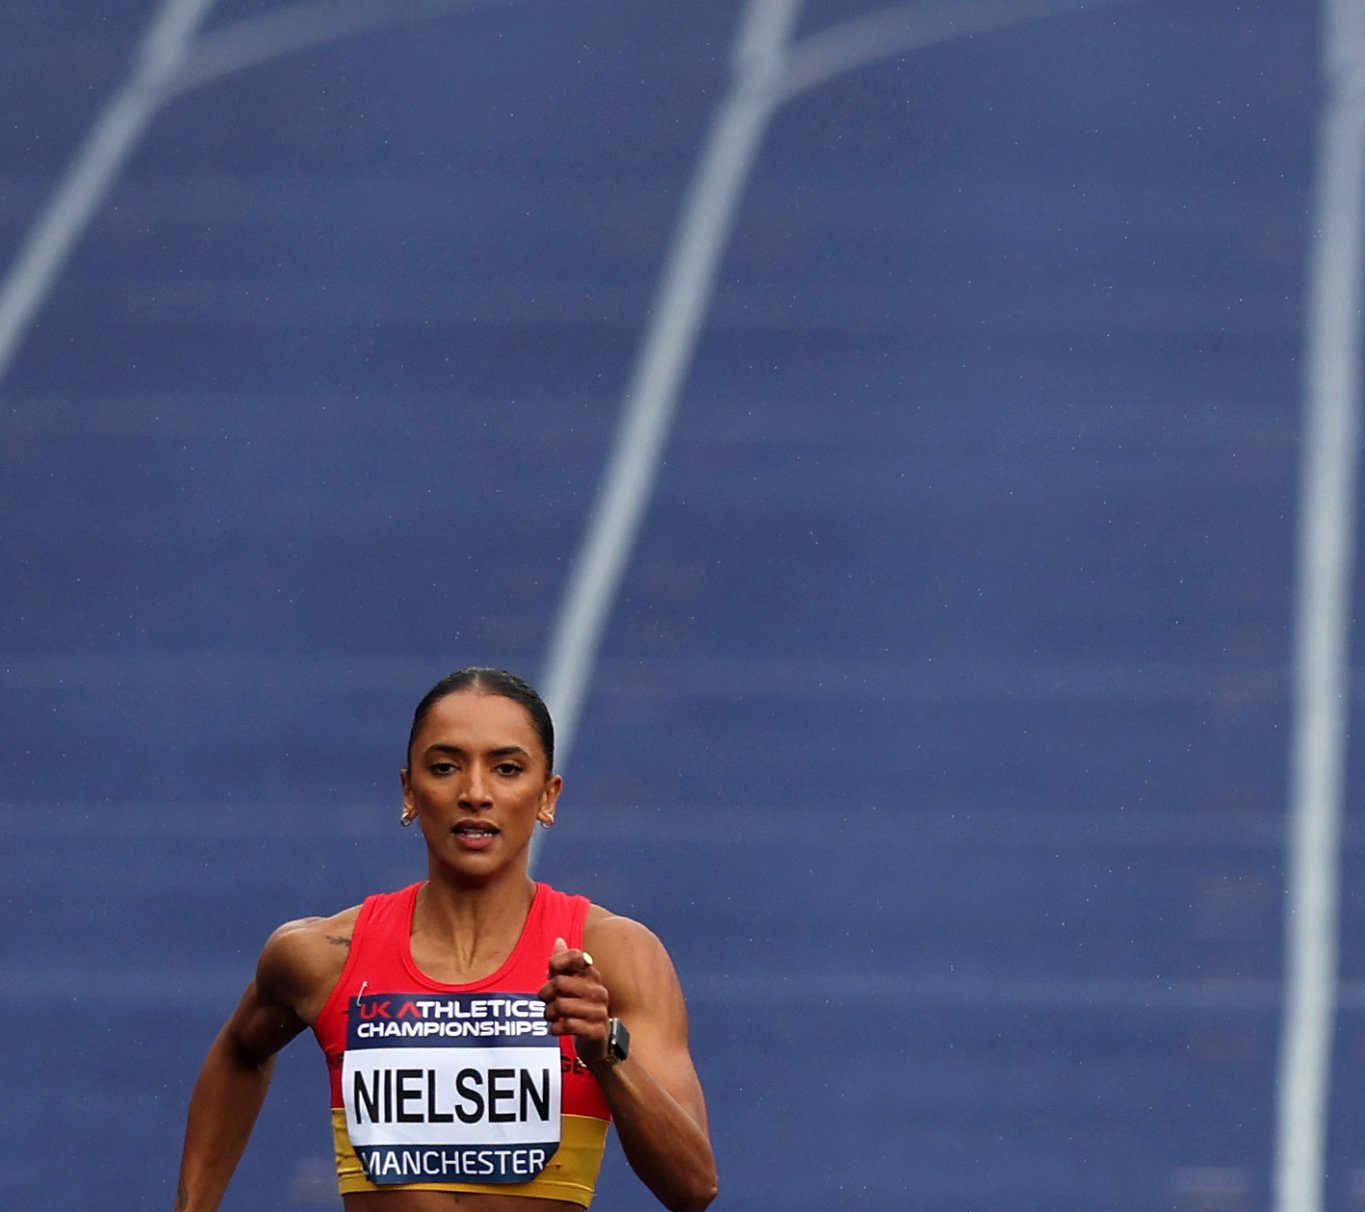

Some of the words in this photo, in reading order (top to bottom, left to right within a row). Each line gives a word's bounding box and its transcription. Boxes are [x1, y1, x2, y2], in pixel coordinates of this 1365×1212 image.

[360, 1001, 391, 1019] UK
[397, 999, 547, 1019] ATHLETICS
[357, 1020, 548, 1039] CHAMPIONSHIPS
[353, 1068, 550, 1124] NIELSEN
[361, 1150, 547, 1176] MANCHESTER
